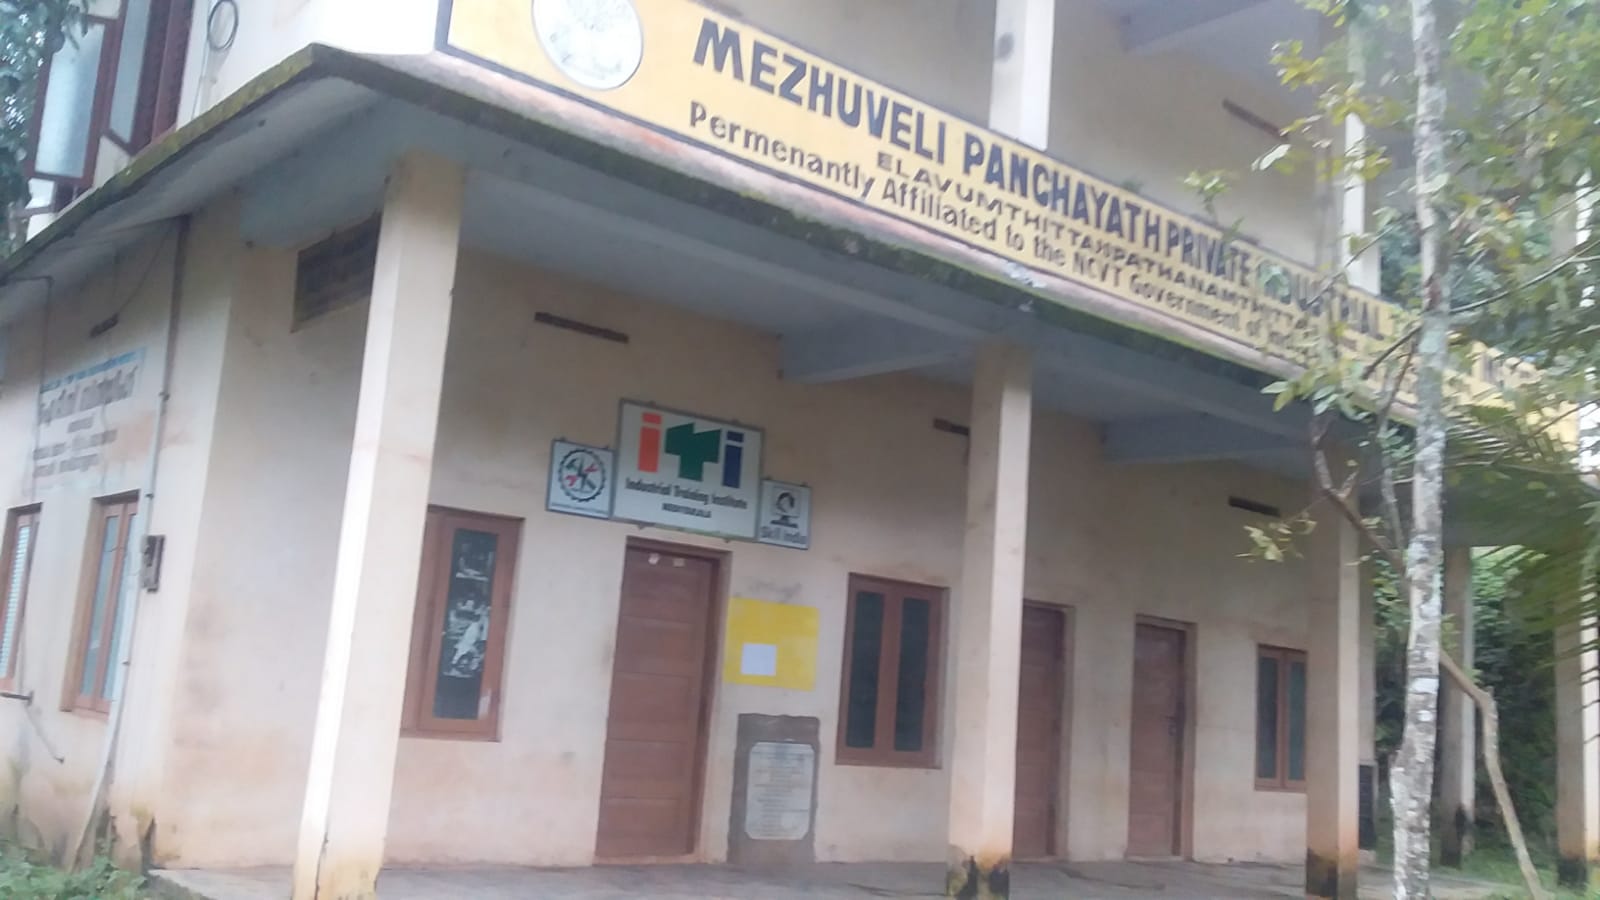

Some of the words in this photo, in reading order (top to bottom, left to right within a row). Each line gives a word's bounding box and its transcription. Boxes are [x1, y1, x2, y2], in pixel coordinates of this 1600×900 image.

[689, 101, 875, 198] Permenantly
[882, 177, 998, 241] Affiliated
[1005, 224, 1025, 251] to
[1033, 236, 1066, 267] the
[1073, 252, 1122, 288] NCVT
[692, 18, 946, 165] MEZHUVELI
[963, 132, 1161, 252] PANCHAYATH
[1166, 219, 1250, 287] PRIVATE
[625, 477, 672, 496] Industrial
